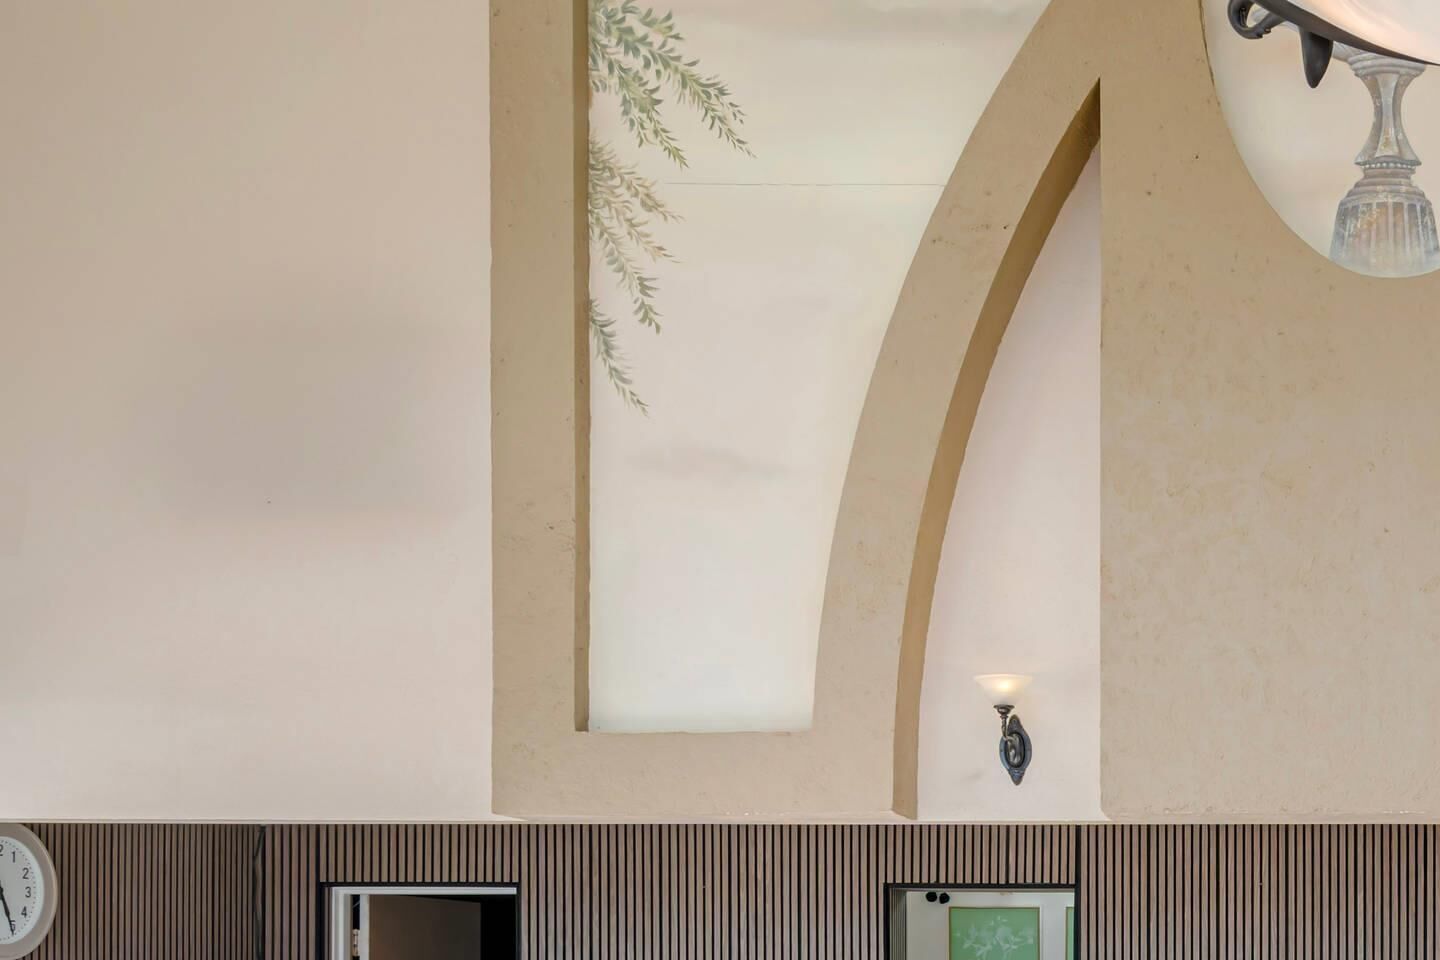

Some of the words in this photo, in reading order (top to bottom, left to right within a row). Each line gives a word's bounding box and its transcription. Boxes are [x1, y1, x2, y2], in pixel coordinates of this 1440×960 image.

[11, 851, 16, 863] 1
[22, 867, 30, 880] 2
[25, 886, 31, 898] 3
[21, 906, 28, 918] 4
